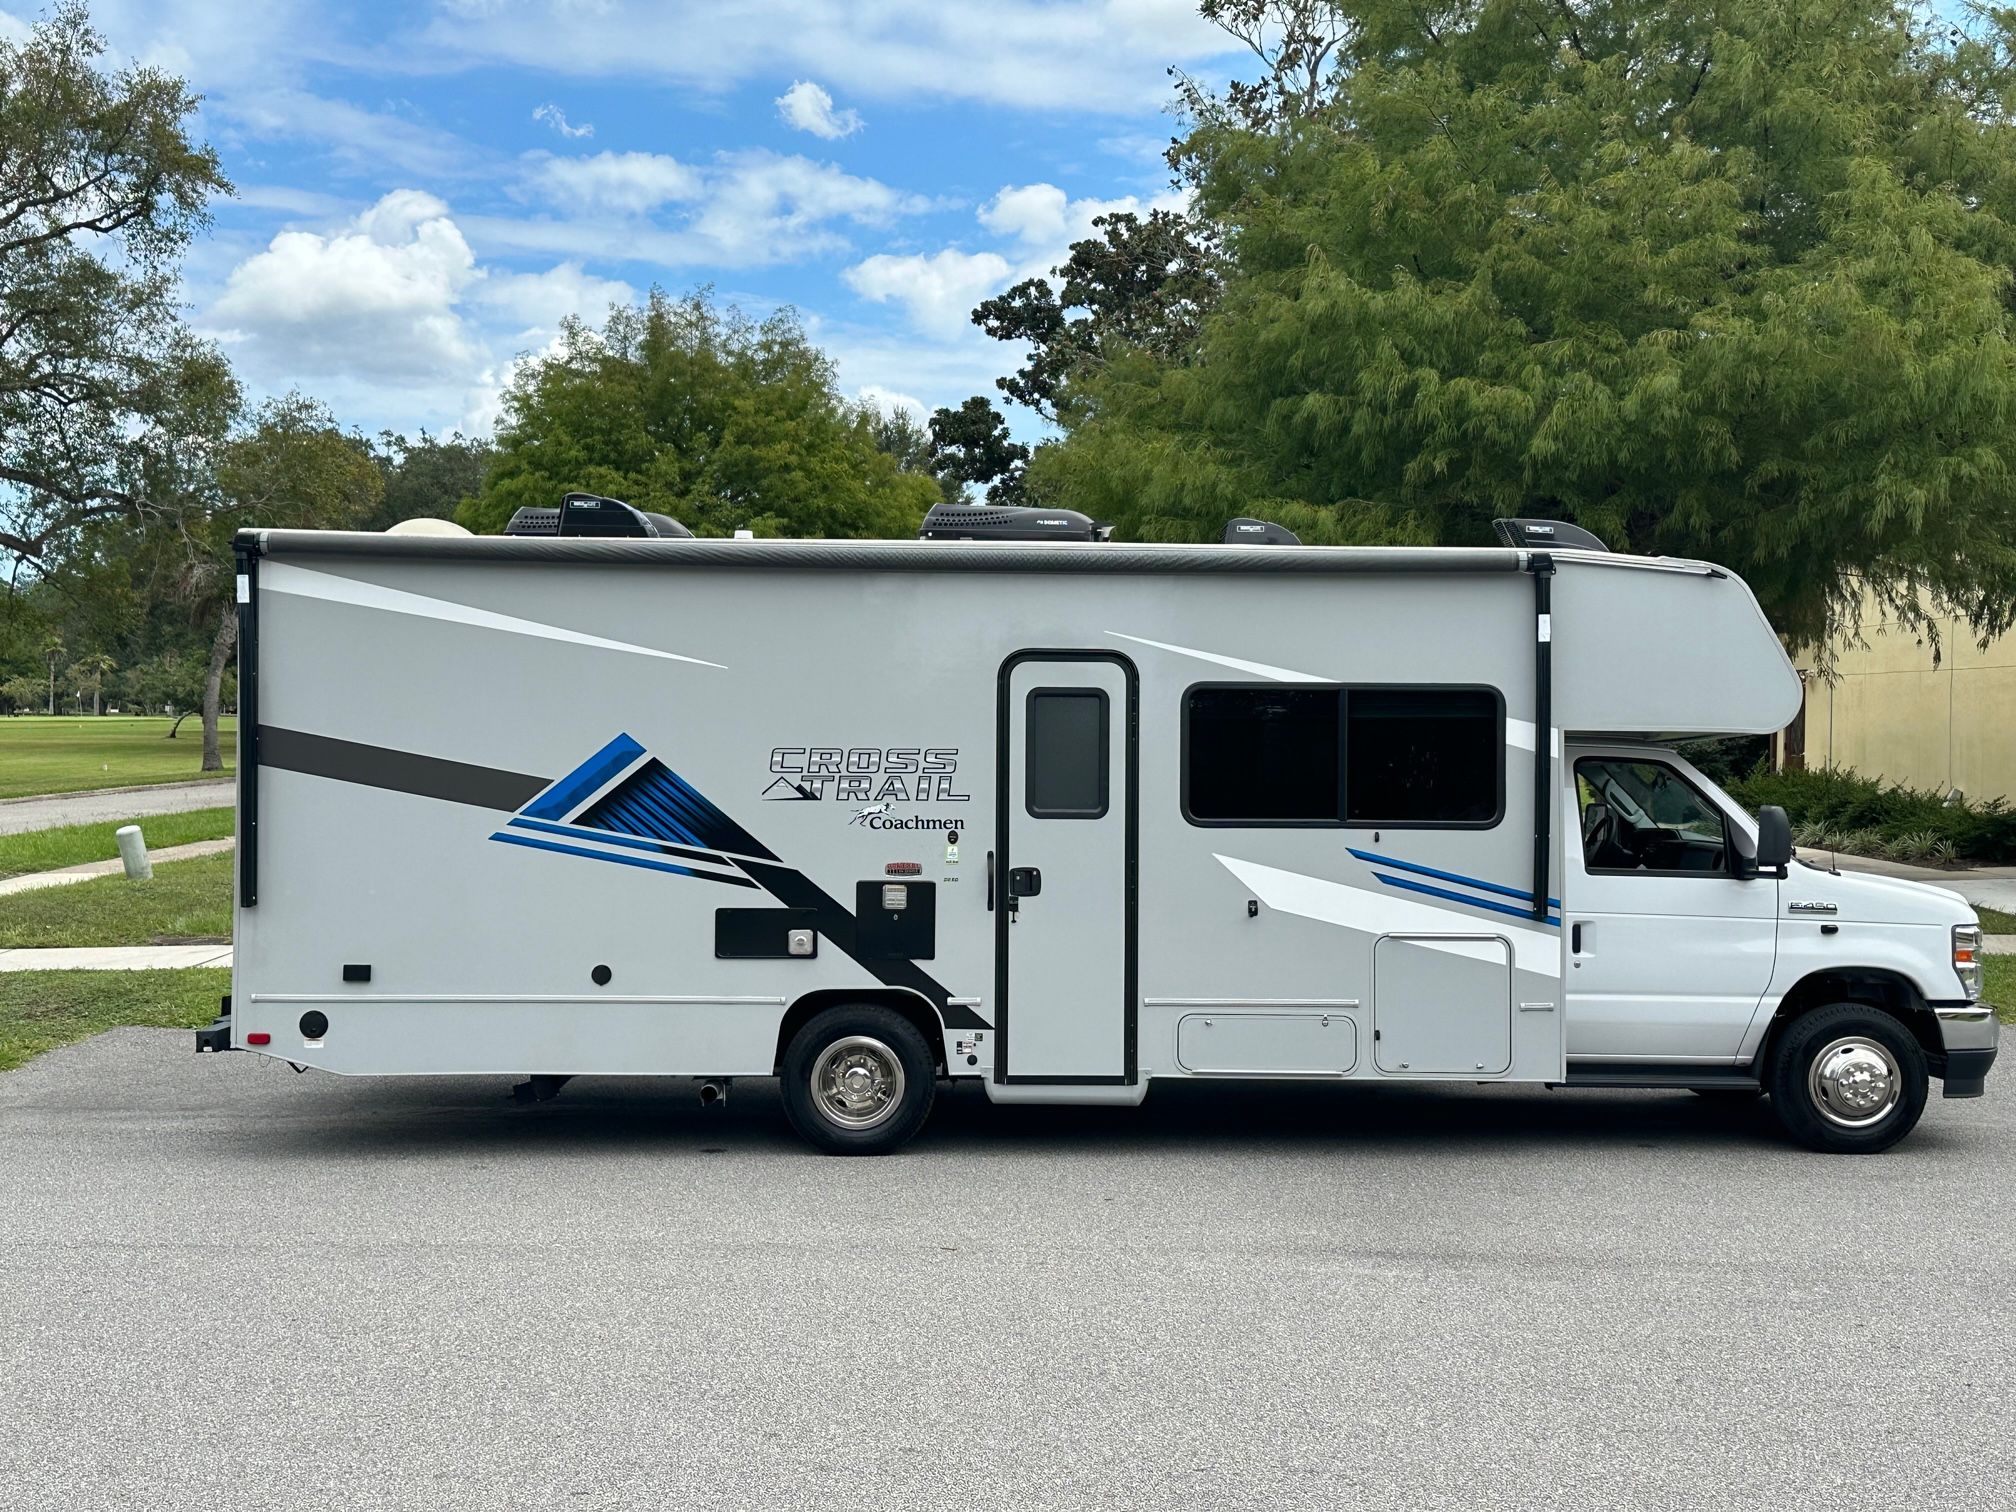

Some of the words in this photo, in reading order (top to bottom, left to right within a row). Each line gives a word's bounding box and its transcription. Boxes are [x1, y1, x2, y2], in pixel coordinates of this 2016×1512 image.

[770, 748, 959, 774] CROSS
[801, 775, 970, 801] TRAIL
[870, 815, 965, 830] Coachmen
